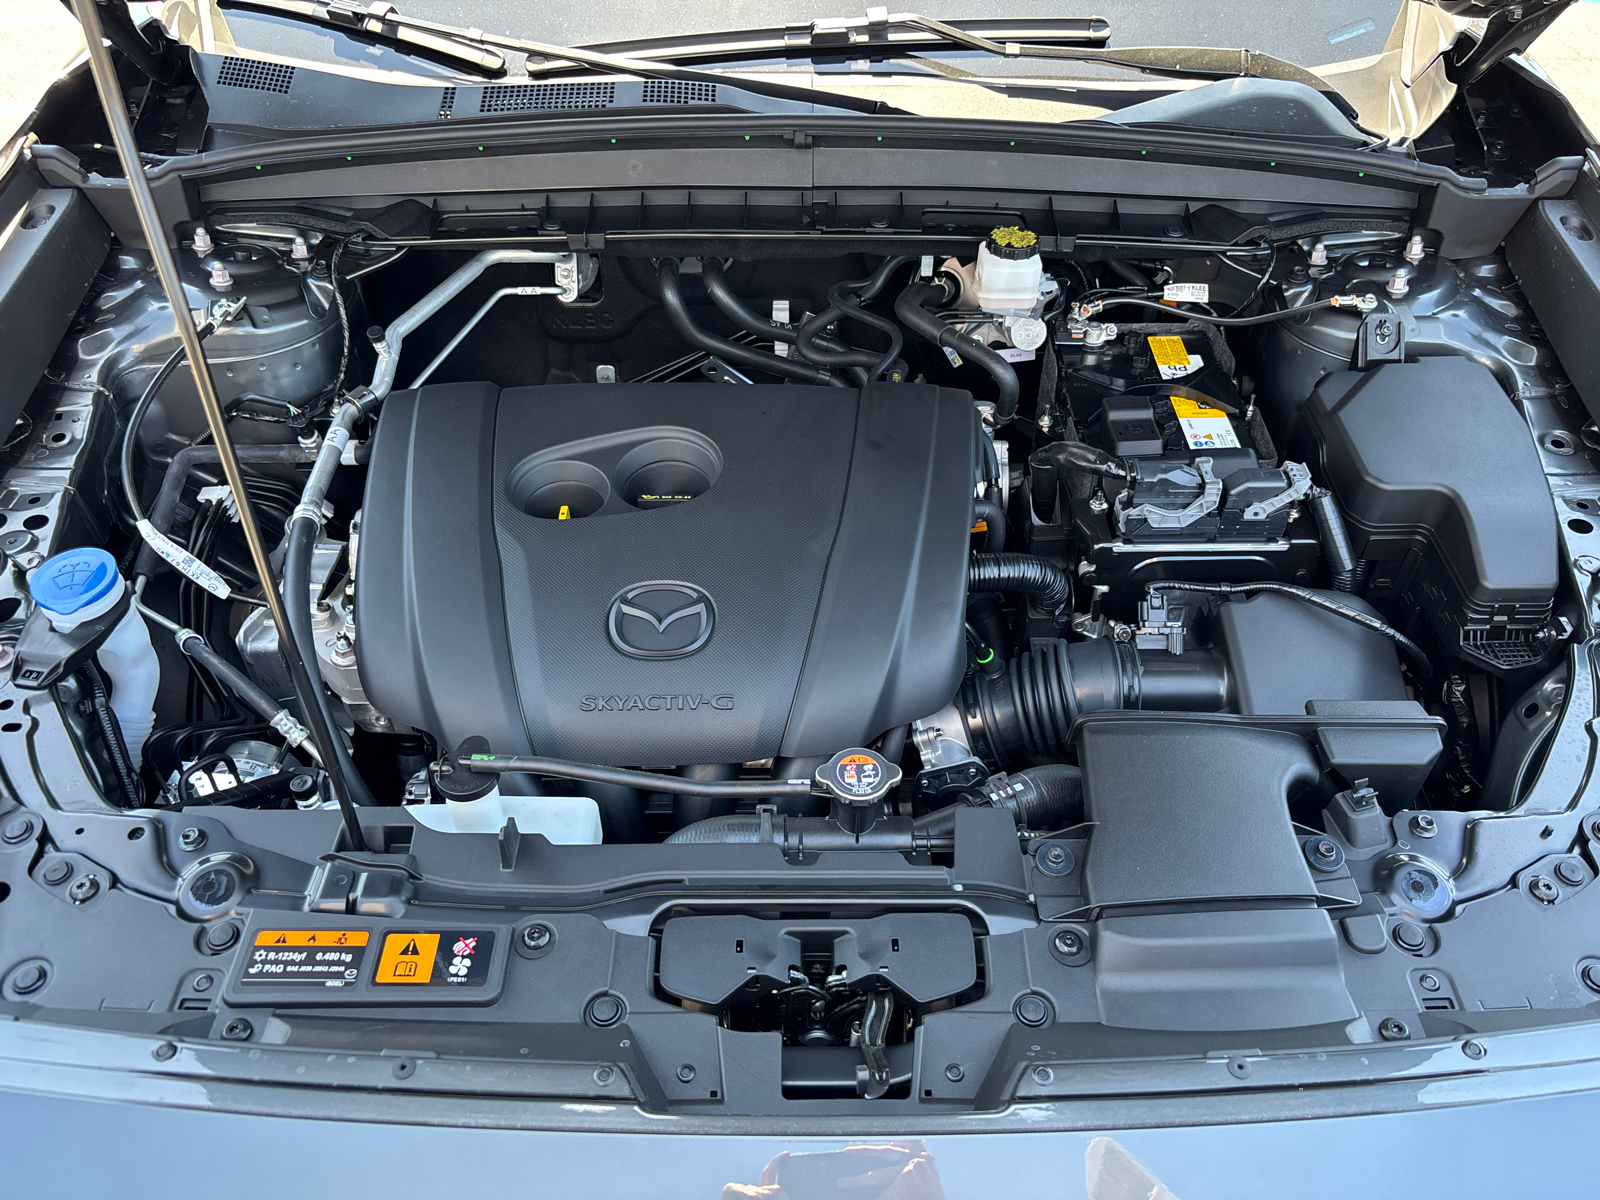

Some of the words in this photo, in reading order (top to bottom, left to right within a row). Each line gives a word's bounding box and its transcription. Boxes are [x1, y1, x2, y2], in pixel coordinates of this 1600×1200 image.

[327, 429, 341, 443] AA
[579, 693, 735, 712] SKYACTIV-G
[267, 951, 307, 962] R-1234yf
[315, 951, 339, 961] 0.480
[340, 951, 353, 963] kg
[262, 963, 284, 973] PAG
